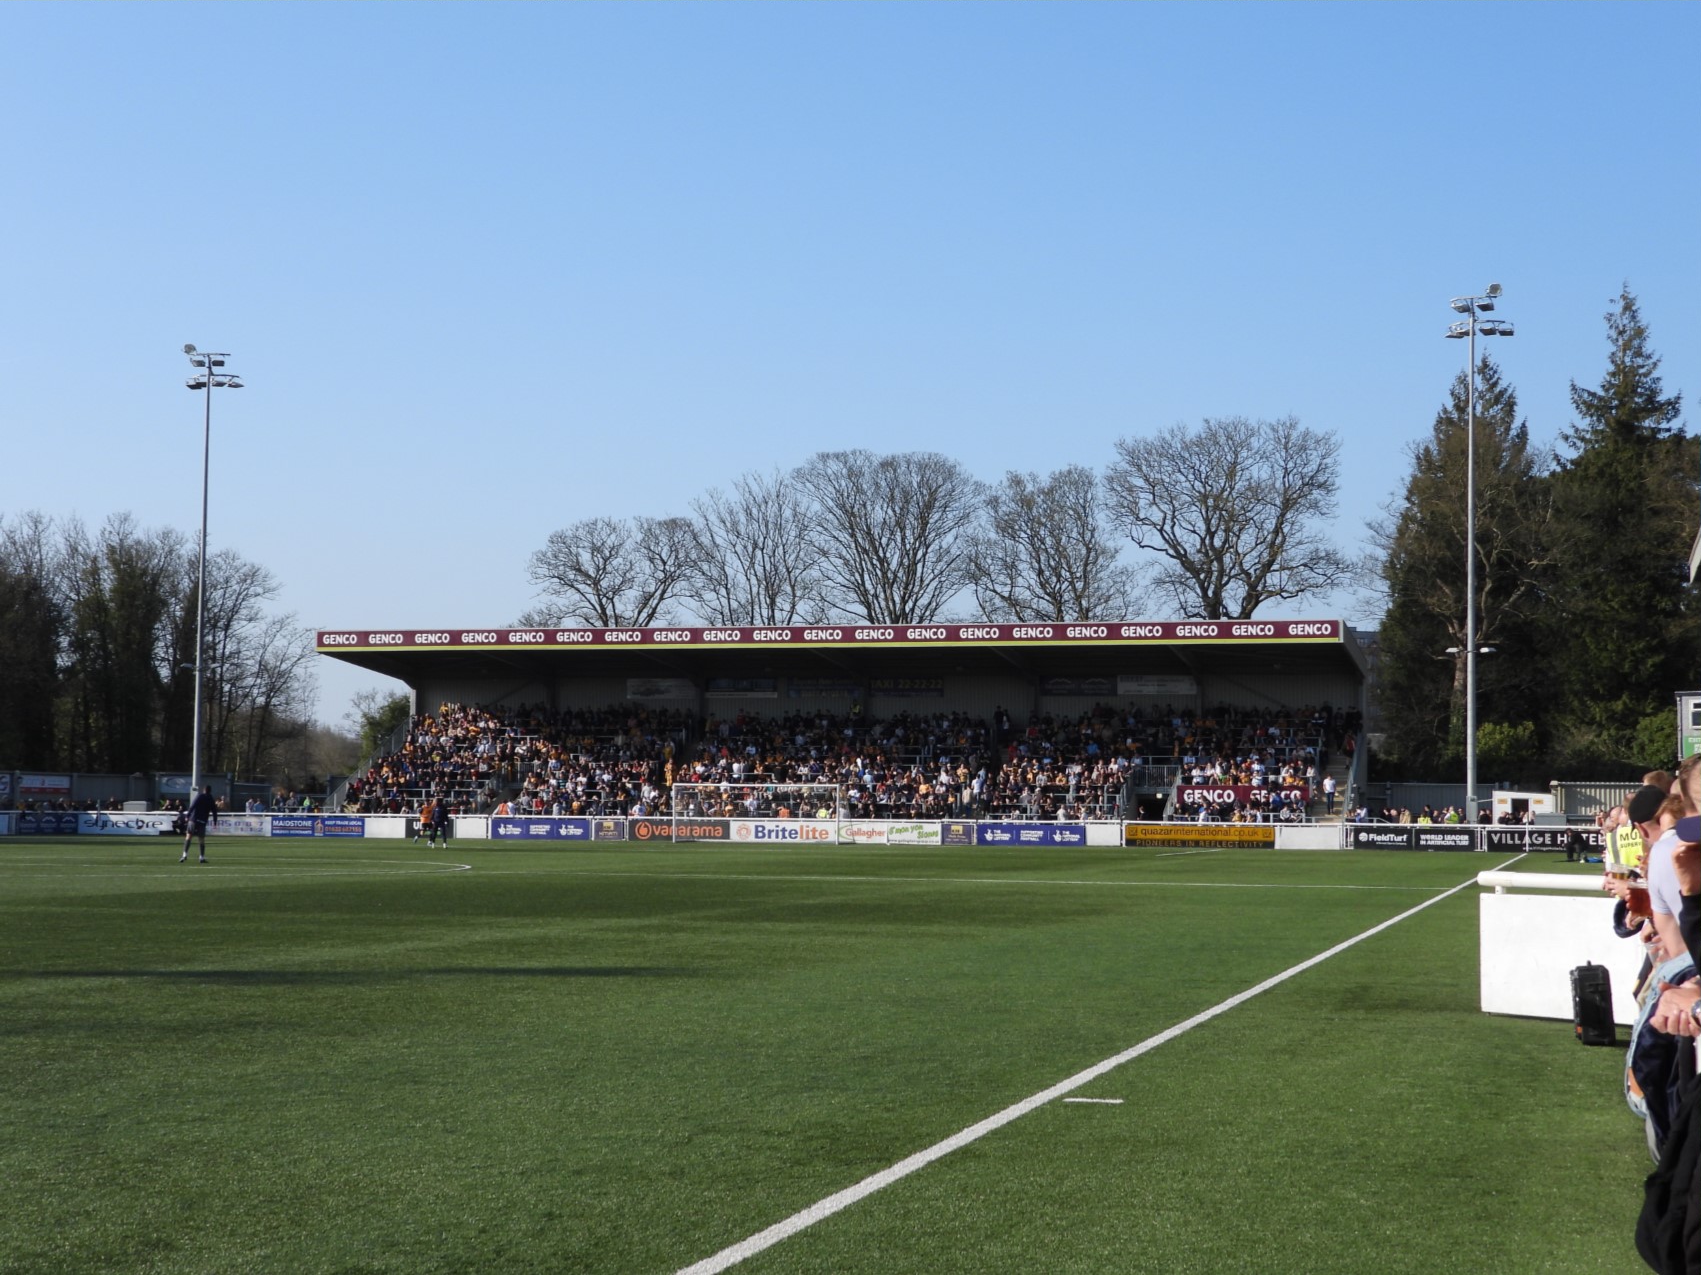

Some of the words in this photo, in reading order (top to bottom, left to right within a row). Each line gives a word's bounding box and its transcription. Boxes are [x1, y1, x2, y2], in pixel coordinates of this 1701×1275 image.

[323, 635, 357, 644] GENCO
[369, 634, 403, 644] GENCO
[415, 633, 449, 643] GENCO
[462, 633, 496, 642] GENCO
[509, 632, 544, 642] GENCO
[557, 632, 592, 642] GENCO
[605, 632, 641, 641] GENCO
[654, 631, 690, 641] GENCO
[703, 631, 740, 641] GENCO
[653, 825, 723, 837] vanarama
[754, 824, 829, 840] Britelite
[845, 828, 886, 838] Gallagher
[1140, 826, 1259, 837] quazarinternational.co.uk
[1368, 833, 1408, 842] FieldTurf
[1491, 833, 1552, 844] VILLAGE
[1136, 839, 1181, 847] PIONEERS
[1199, 840, 1264, 848] REFLECTIVITY
